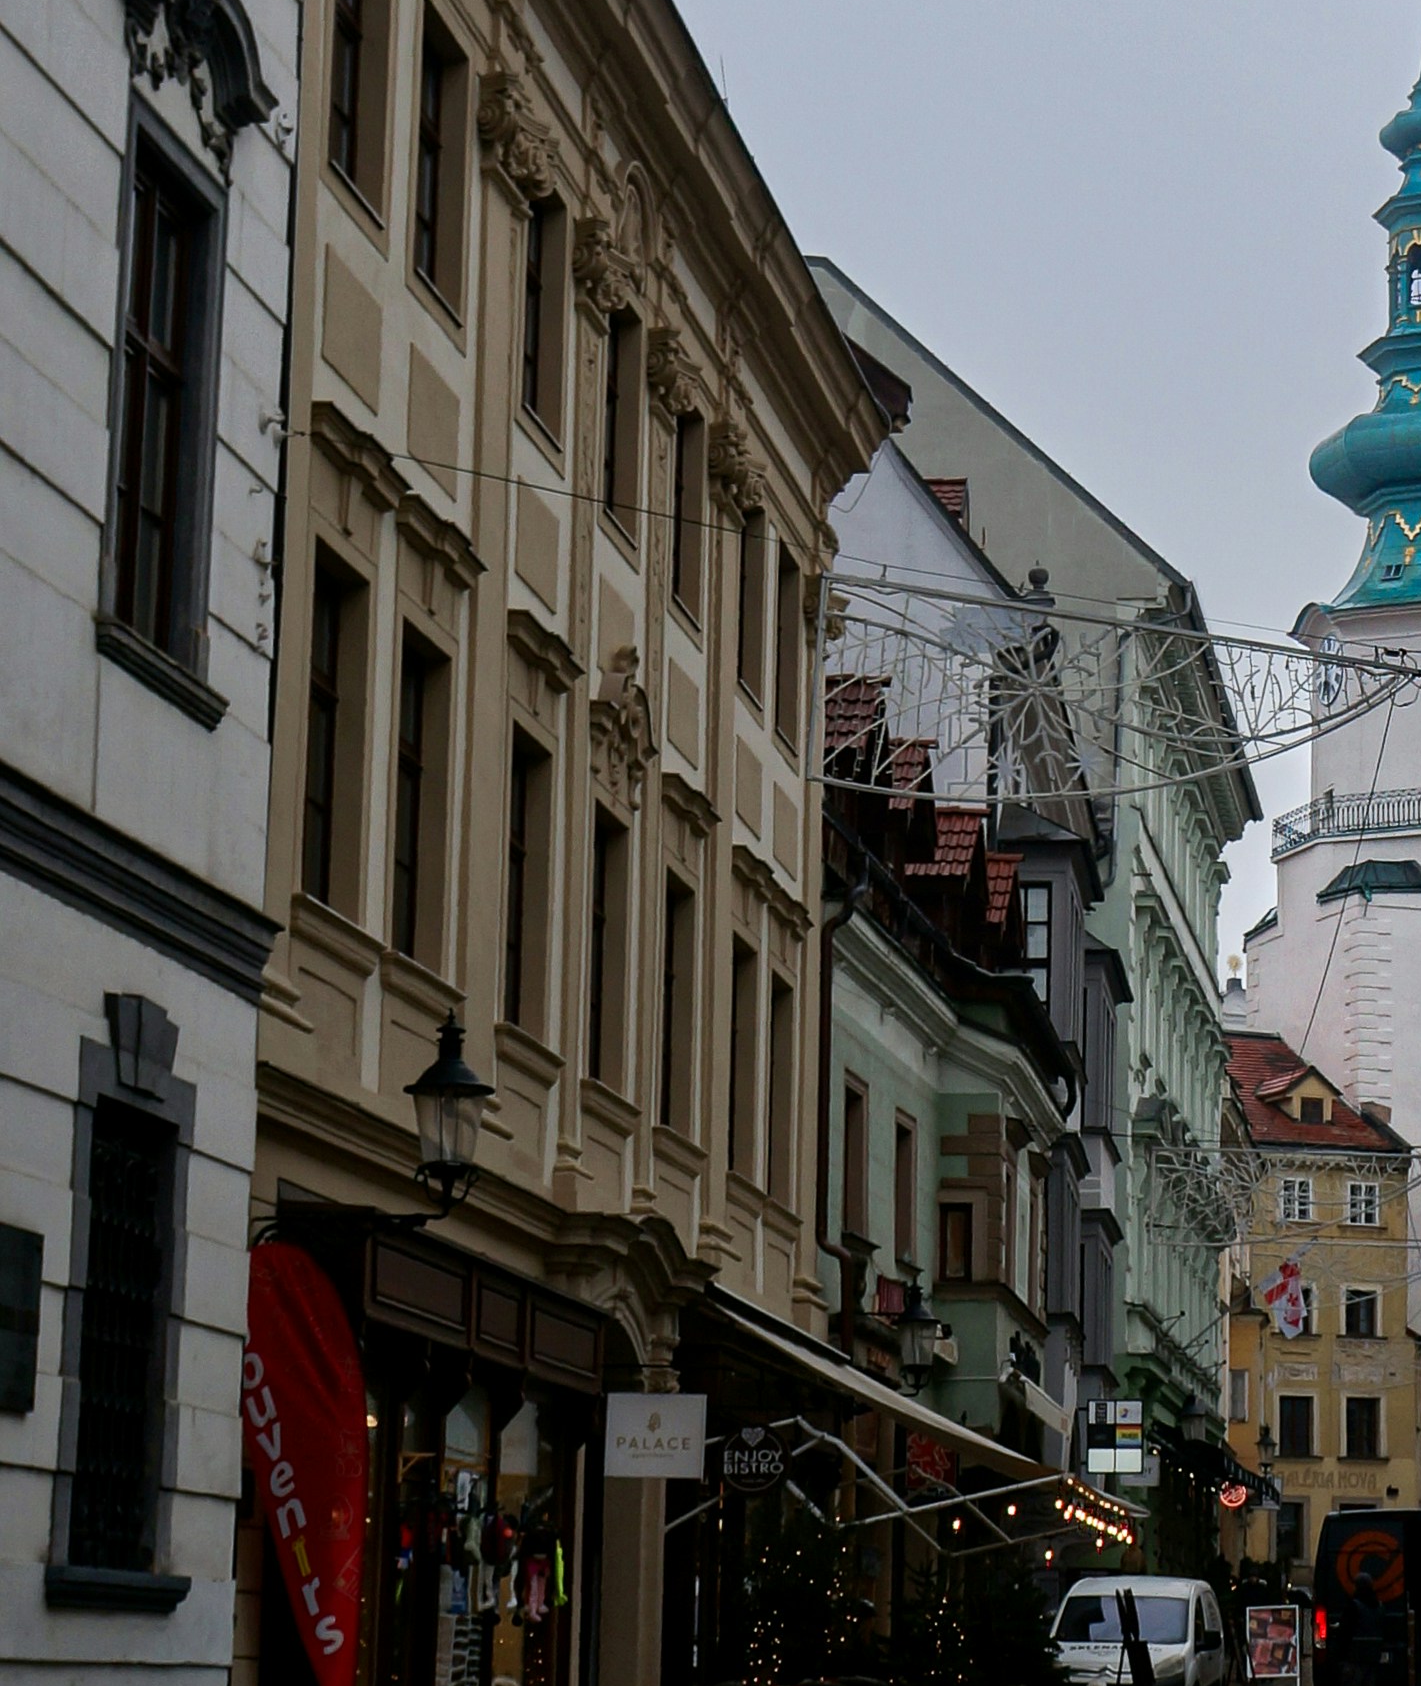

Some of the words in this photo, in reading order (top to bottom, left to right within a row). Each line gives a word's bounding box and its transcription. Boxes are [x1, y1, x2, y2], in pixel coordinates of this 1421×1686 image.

[616, 1437, 691, 1451] PALACE
[724, 1449, 783, 1462] ENJOY
[723, 1462, 784, 1475] BISTRO
[242, 1333, 346, 1657] ouvenirs
